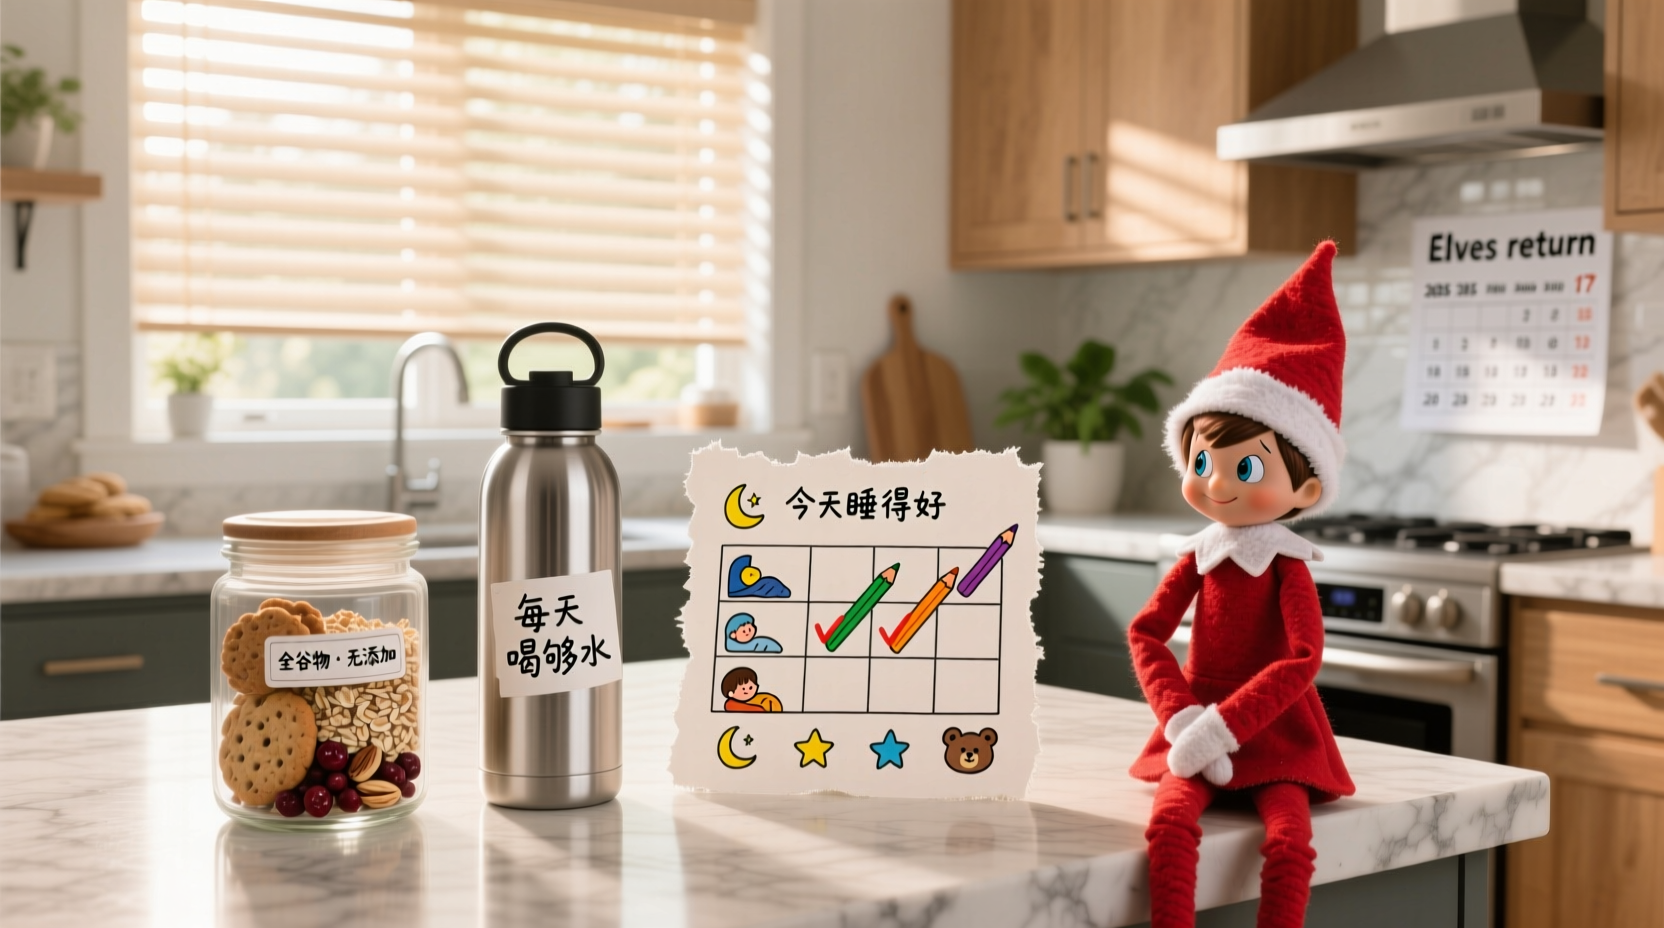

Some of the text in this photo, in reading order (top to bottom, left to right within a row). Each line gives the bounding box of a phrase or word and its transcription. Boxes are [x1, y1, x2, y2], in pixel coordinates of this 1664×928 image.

[1429, 230, 1596, 263] Elves return
[1575, 273, 1597, 293] 17
[785, 486, 946, 522] 今天睡得好
[514, 593, 583, 633] 每天
[507, 634, 611, 678] 喝够水
